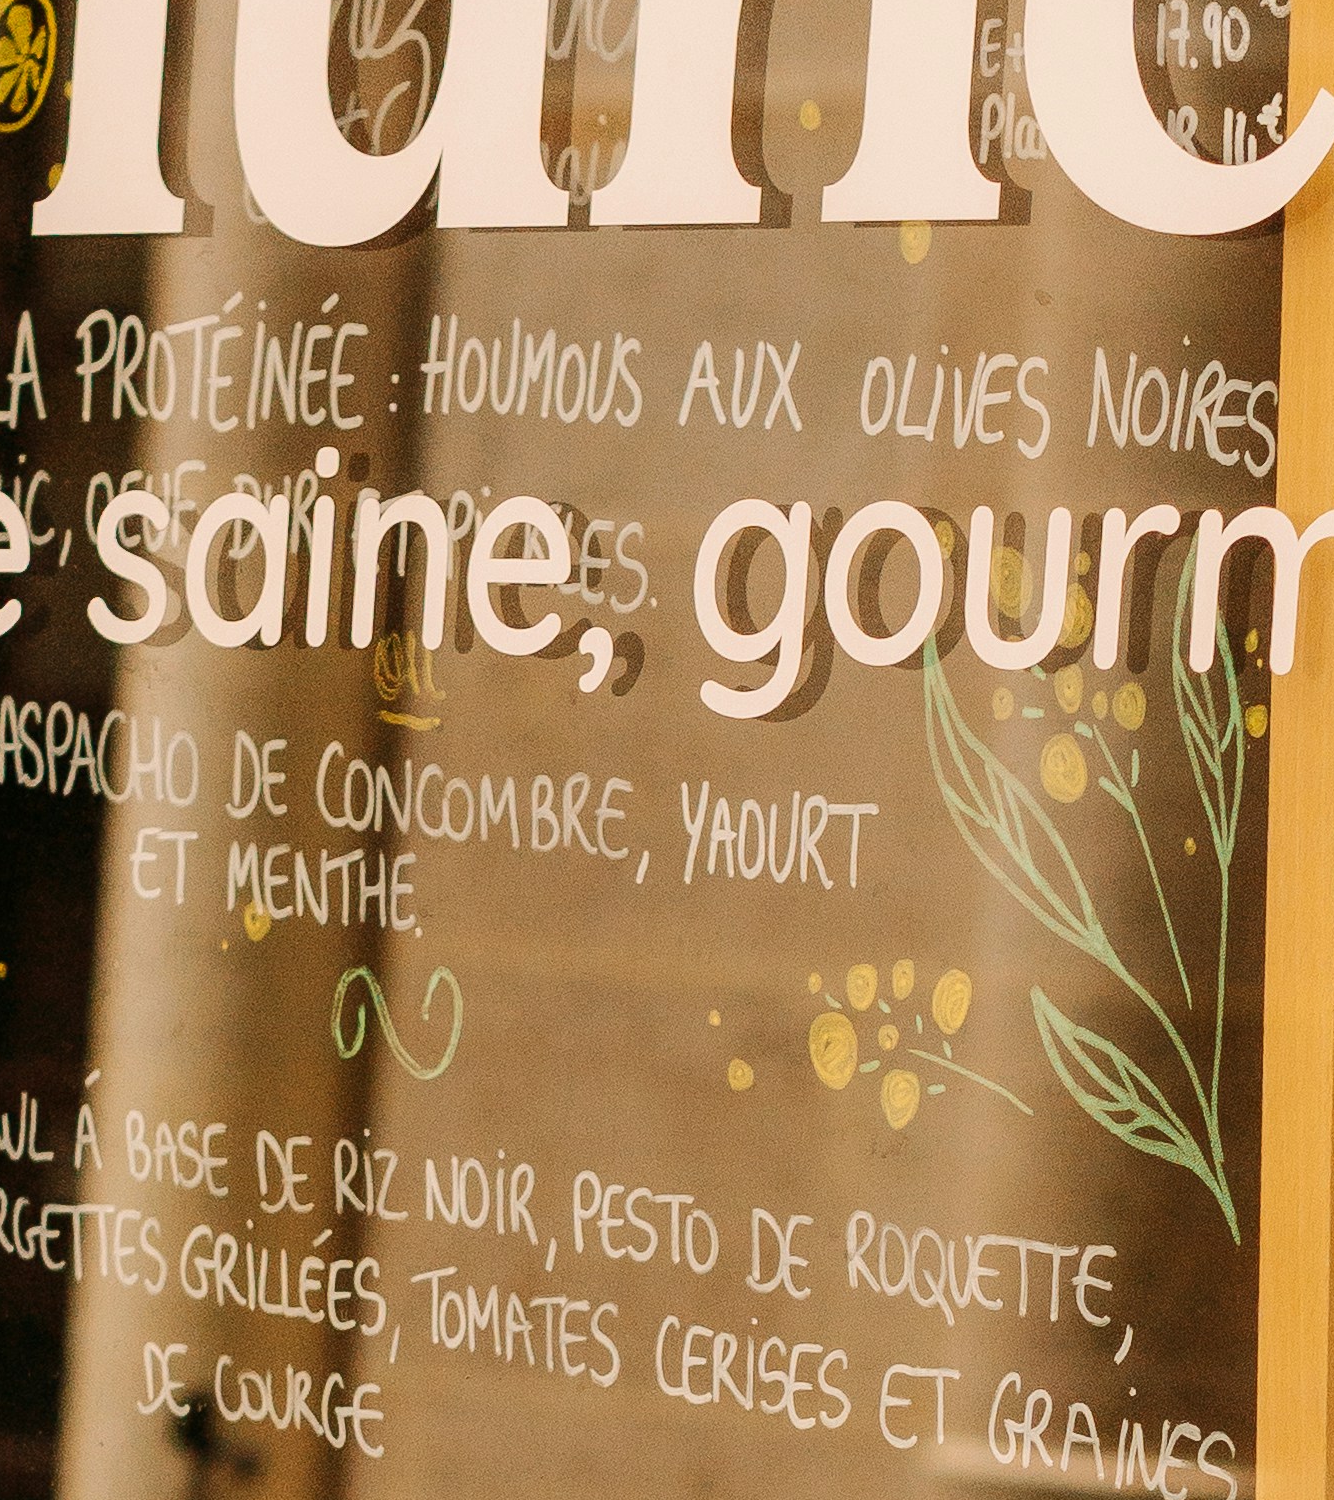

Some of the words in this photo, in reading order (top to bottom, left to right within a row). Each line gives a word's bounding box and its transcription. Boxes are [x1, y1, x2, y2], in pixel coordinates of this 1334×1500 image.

[76, 292, 370, 432] PROTÉINÉE
[420, 312, 643, 429] HOUMOUS
[679, 339, 803, 433] AUX
[860, 345, 1052, 460] OLIVES
[1087, 335, 1278, 479] NOIRES
[87, 445, 614, 693] saine,
[130, 826, 198, 905] ET
[226, 840, 424, 938] MENTHE.
[225, 730, 288, 819] DE
[316, 740, 651, 886] CONCOMBRE,
[681, 780, 880, 890] YAOURT
[124, 1108, 230, 1198] BASE
[255, 1128, 314, 1215] DE
[334, 1128, 408, 1222] RIZ
[424, 1150, 558, 1272] NOIR,
[573, 1170, 720, 1276] PESTO
[745, 1206, 815, 1302] DE
[845, 1210, 1135, 1366] ROQUETTE,
[136, 1341, 192, 1418] DE
[214, 1354, 386, 1458] COURGE
[180, 1218, 401, 1364] GRILLÉES,
[410, 1266, 621, 1389] TOMATES
[655, 1315, 853, 1431] CERISES
[878, 1362, 963, 1451] ET
